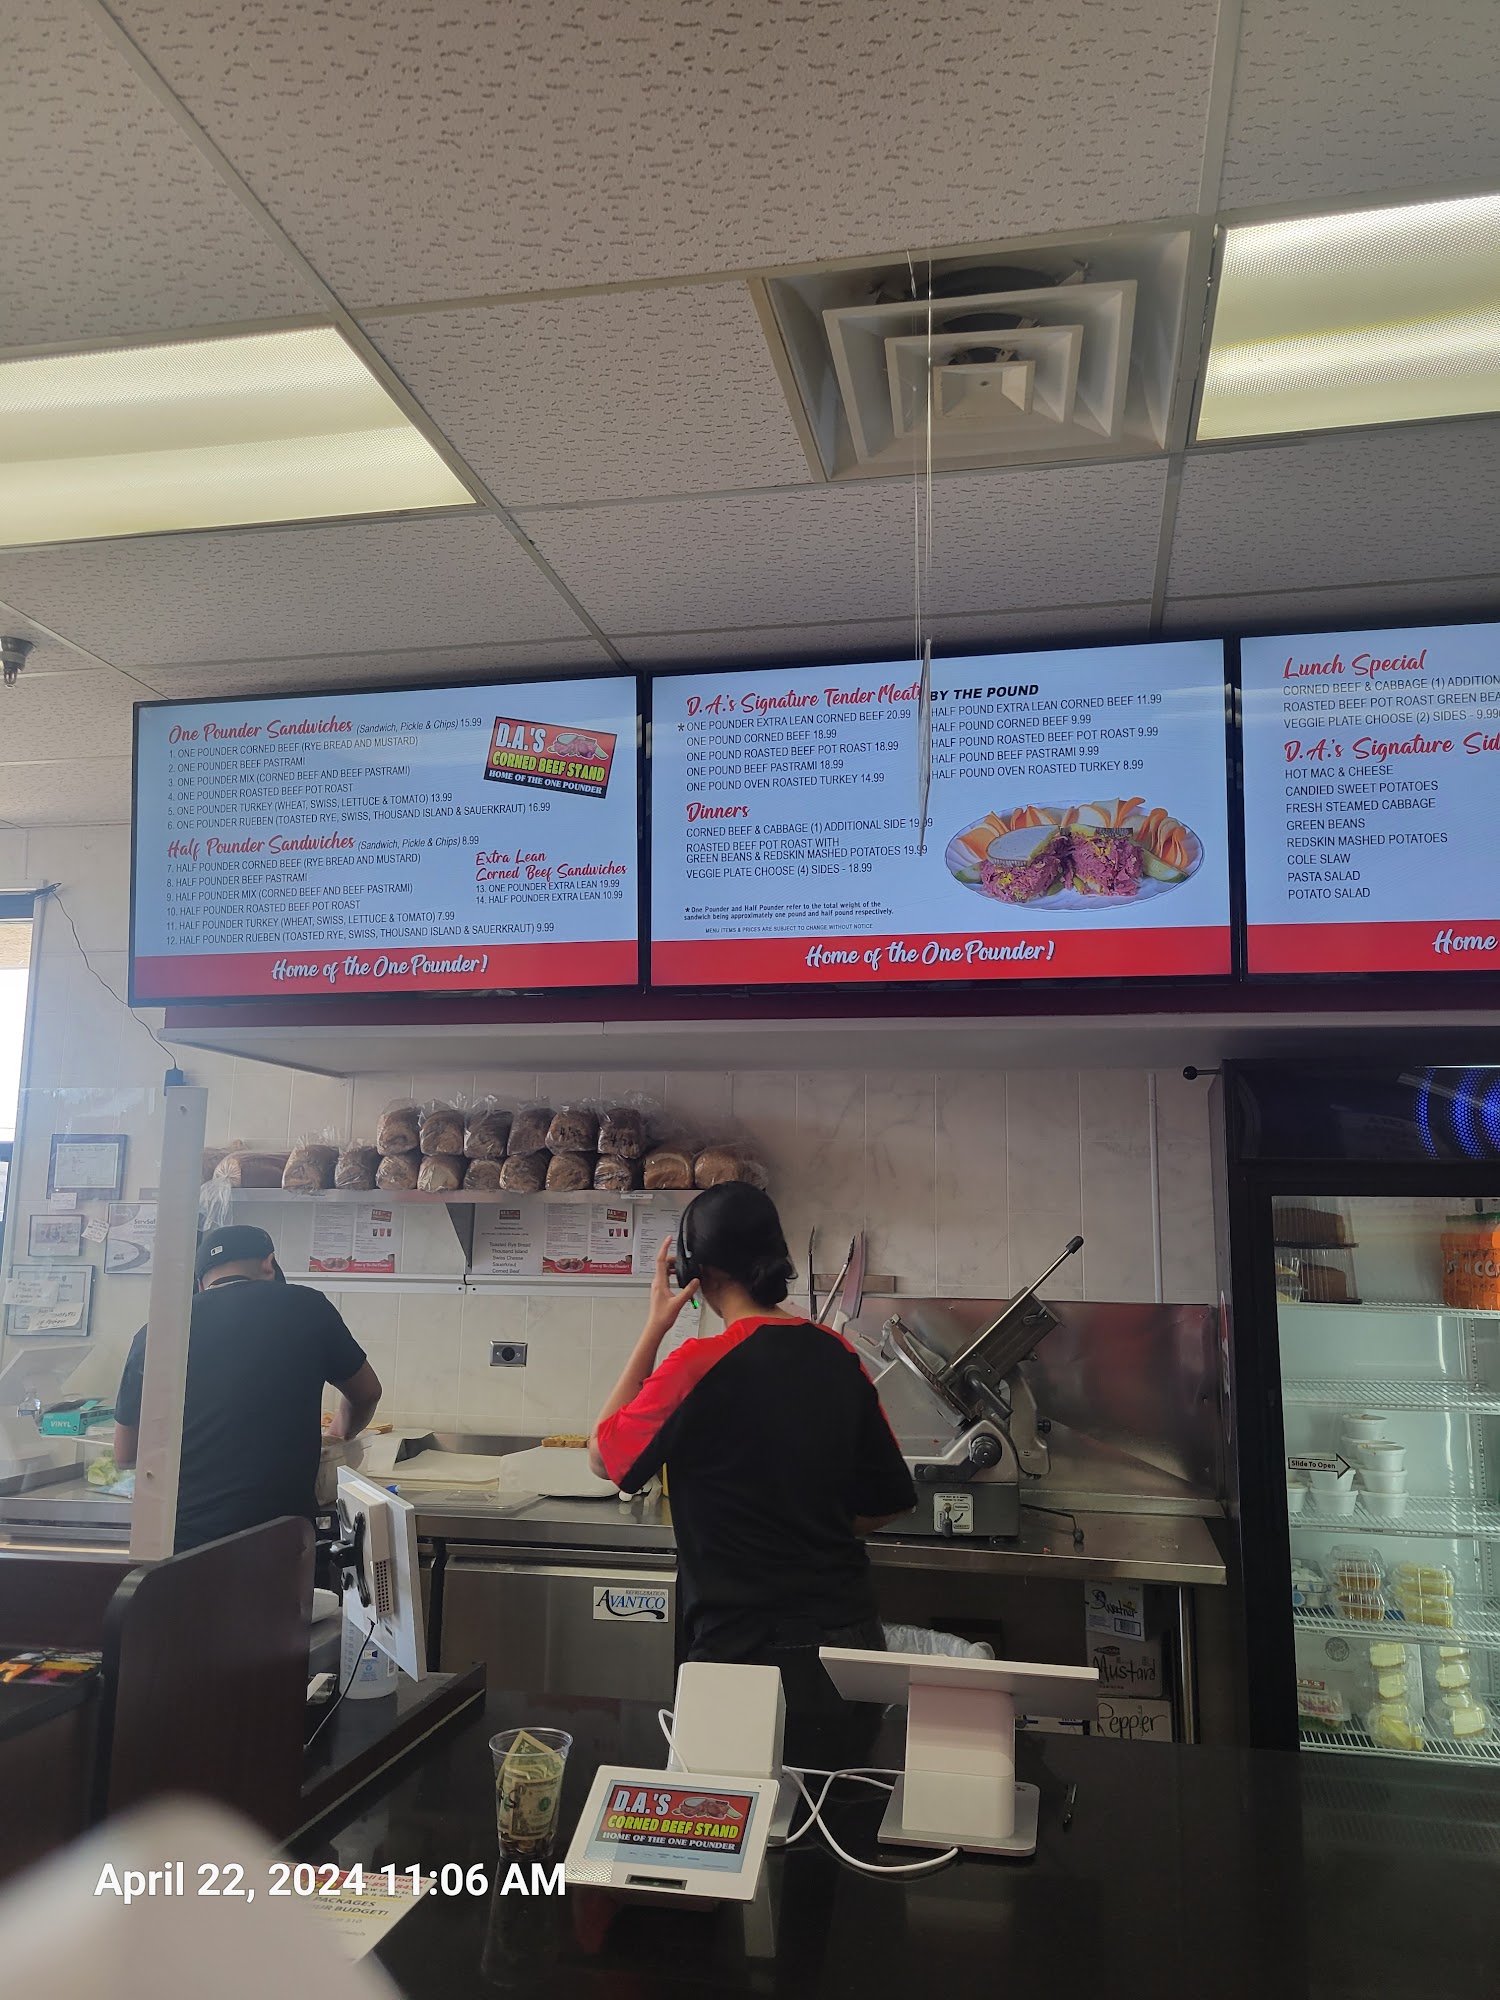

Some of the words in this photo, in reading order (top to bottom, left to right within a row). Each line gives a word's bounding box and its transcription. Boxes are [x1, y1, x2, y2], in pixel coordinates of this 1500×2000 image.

[1283, 654, 1345, 679] Lunch
[1351, 649, 1427, 679] Special
[741, 690, 819, 716] Signature
[824, 687, 876, 708] Tender
[930, 690, 949, 701] BY
[953, 688, 982, 699] THE
[986, 684, 1039, 698] POUND
[169, 725, 199, 745] One
[204, 723, 262, 742] Pounder
[267, 715, 352, 739] Sandwiches
[356, 720, 399, 734] (Sandwich,
[401, 720, 424, 732] Pickle
[426, 721, 432, 730] &
[434, 718, 459, 731] Chips)
[461, 717, 482, 728] 15.99
[932, 721, 956, 733] HALF
[958, 719, 994, 731] POUND
[996, 716, 1039, 729] CORNED
[1042, 715, 1070, 726] BEEF
[1071, 714, 1091, 725] 9.99
[495, 723, 546, 753] D.A.'S
[687, 735, 706, 747] ONE
[708, 733, 741, 745] POUND
[743, 731, 784, 743] CORNED
[786, 730, 810, 741] BEEF
[812, 728, 836, 740] 18.99
[932, 753, 956, 764] HALF
[959, 751, 994, 763] POUND
[996, 749, 1023, 761] BEEF
[1025, 746, 1076, 759] PASTRAMI
[1078, 745, 1099, 756] 9.99
[1352, 733, 1454, 763] Signature
[169, 763, 175, 774] 2.
[177, 762, 195, 773] ONE
[197, 760, 237, 772] POUNDER
[239, 758, 261, 770] BEEF
[263, 756, 305, 769] PASTRAMI
[492, 751, 537, 772] CORNED
[539, 757, 566, 776] BEEF
[568, 762, 605, 782] STAND
[687, 766, 706, 777] ONE
[708, 764, 741, 776] POUND
[743, 763, 768, 774] BEEF
[770, 760, 817, 773] PASTRAMI
[819, 758, 843, 770] 18.99
[1285, 768, 1308, 780] HOT
[1310, 767, 1334, 779] MAC
[1338, 766, 1345, 778] &
[1348, 764, 1393, 777] CHEESE
[488, 769, 513, 781] HOME
[514, 773, 526, 782] OF
[527, 775, 543, 785] THE
[544, 777, 562, 788] ONE
[562, 779, 603, 795] POUNDER
[1286, 784, 1334, 797] CANDIED
[1337, 782, 1377, 795] SWEET
[1379, 780, 1438, 793] POTATOES
[686, 802, 750, 822] Dinners
[1286, 802, 1322, 814] FRESH
[1325, 799, 1379, 813] STEAMED
[1381, 797, 1435, 810] CABBAGE
[1287, 819, 1326, 831] GREEN
[1327, 817, 1365, 830] BEANS
[167, 838, 200, 861] Half
[207, 836, 265, 856] Pounder
[269, 831, 355, 854] Sandwiches
[1287, 836, 1335, 848] REDSKIN
[1337, 834, 1385, 847] MASHED
[1388, 832, 1447, 845] POTATOES
[476, 851, 510, 866] Extra
[516, 849, 546, 863] Lean
[1287, 853, 1316, 865] COLE
[1320, 853, 1350, 864] SLAW
[476, 867, 519, 881] Corned
[526, 864, 552, 882] Beef
[557, 860, 627, 879] Sandwiches
[687, 868, 721, 879] VEGGIE
[723, 867, 752, 878] PLATE
[754, 865, 795, 877] CHOOSE
[797, 864, 808, 877] (4)
[811, 863, 839, 875] SIDES
[846, 862, 872, 873] 18.99
[1288, 871, 1322, 883] PASTA
[1324, 870, 1360, 882] SALAD
[476, 884, 487, 894] 13.
[488, 883, 505, 893] ONE
[507, 882, 546, 892] POUNDER
[548, 880, 574, 891] EXTRA
[576, 879, 597, 890] LEAN
[600, 879, 620, 889] 19.99
[1288, 888, 1331, 900] POTATO
[1334, 887, 1370, 899] SALAD
[476, 895, 487, 904] 14.
[488, 894, 508, 904] HALF
[510, 893, 549, 903] POUNDER
[551, 892, 578, 902] EXTRA
[579, 891, 600, 901] LEAN
[602, 890, 622, 900] 10.99
[1432, 928, 1498, 955] Home
[805, 944, 859, 967] Home
[863, 949, 882, 971] of
[885, 941, 919, 963] the
[921, 941, 963, 965] One
[965, 939, 1055, 961] Pounder!
[272, 958, 319, 981] Home
[322, 961, 338, 984] of
[342, 956, 371, 975] the
[373, 955, 409, 978] One
[411, 953, 489, 976] Pounder!
[596, 1589, 666, 1614] AVANTCO
[1092, 1654, 1156, 1683] Mustard
[1097, 1702, 1168, 1739] Pepper
[612, 1790, 672, 1816] D.A.'S
[607, 1814, 659, 1832] CORNED
[661, 1819, 693, 1835] BEEF
[694, 1822, 739, 1839] STAND
[603, 1831, 631, 1841] HOME
[632, 1834, 646, 1842] OF
[647, 1835, 667, 1844] THE
[668, 1837, 687, 1846] ONE
[689, 1839, 735, 1850] POUNDER
[313, 1896, 377, 1907] PACKAGES
[334, 1905, 388, 1916] BUDGET!
